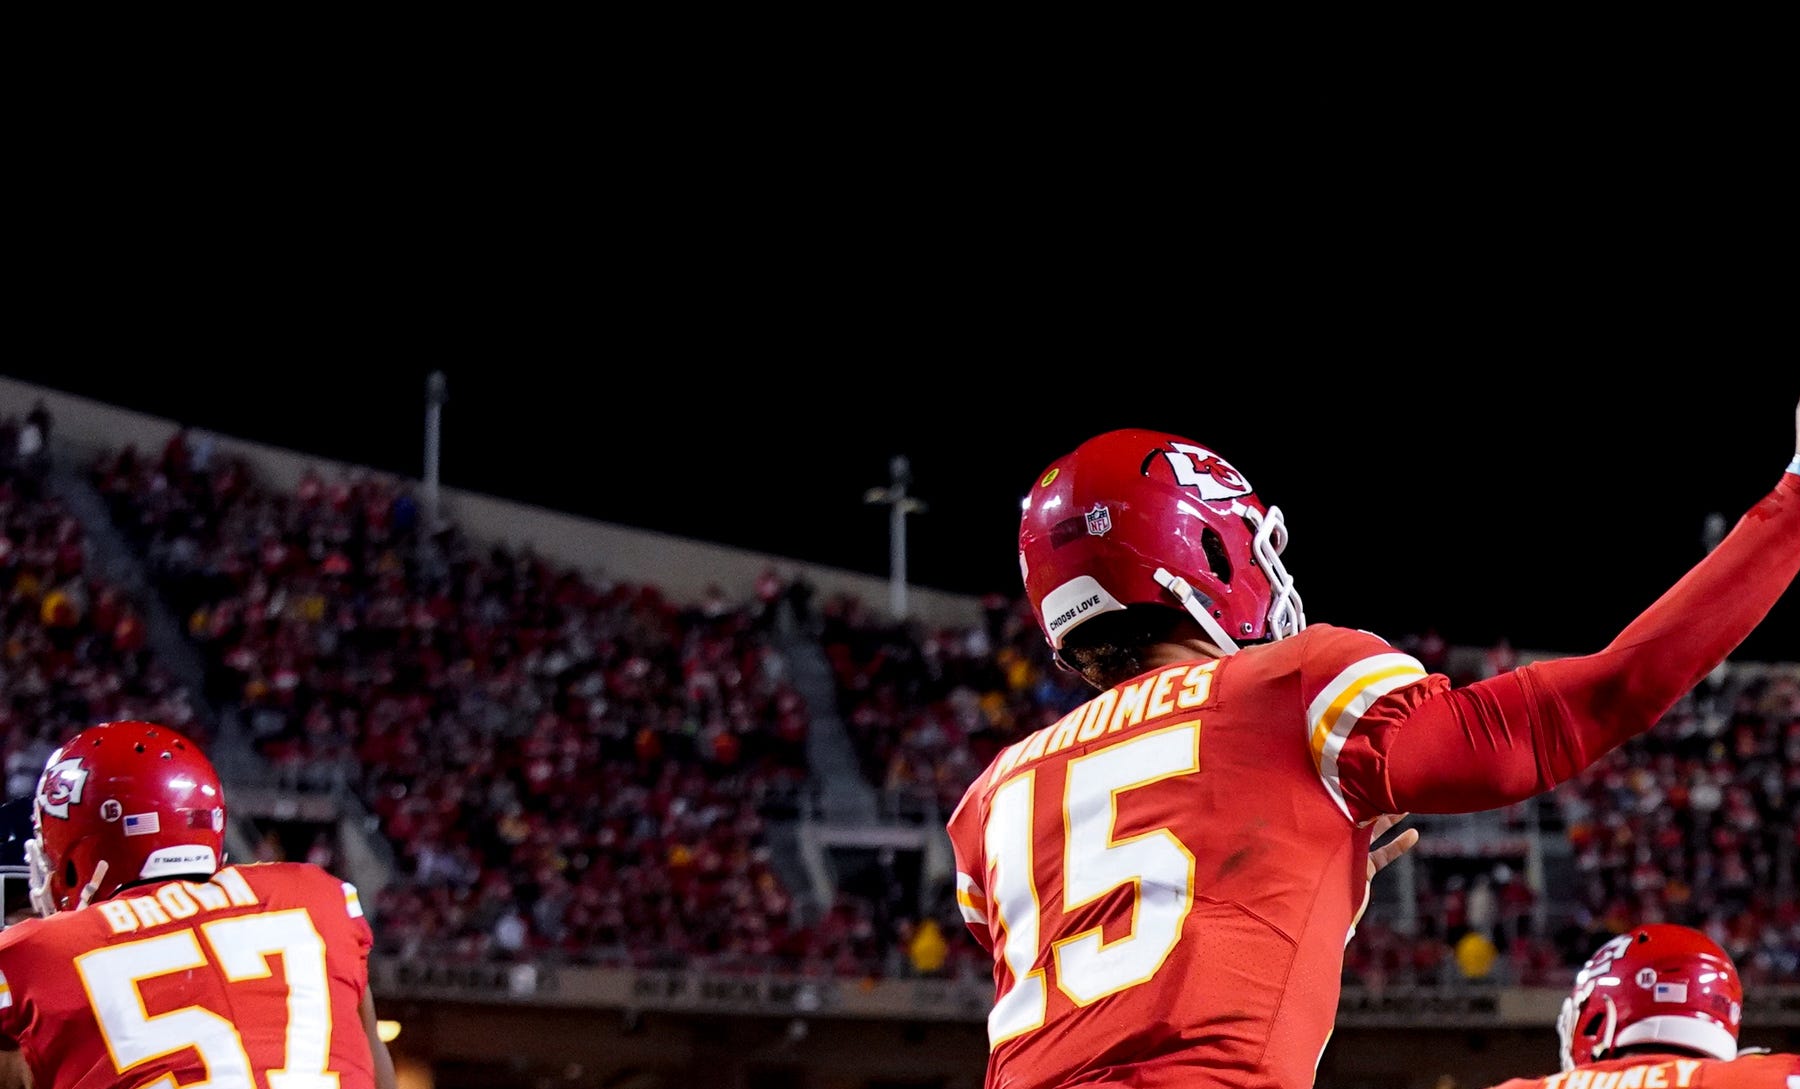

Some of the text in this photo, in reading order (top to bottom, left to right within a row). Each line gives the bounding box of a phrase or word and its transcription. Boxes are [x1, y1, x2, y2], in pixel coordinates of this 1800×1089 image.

[1049, 594, 1101, 631] CHOOSE LOVE
[987, 659, 1221, 789] MAHOMES
[100, 866, 259, 934] BROWN
[987, 719, 1201, 1053] 15
